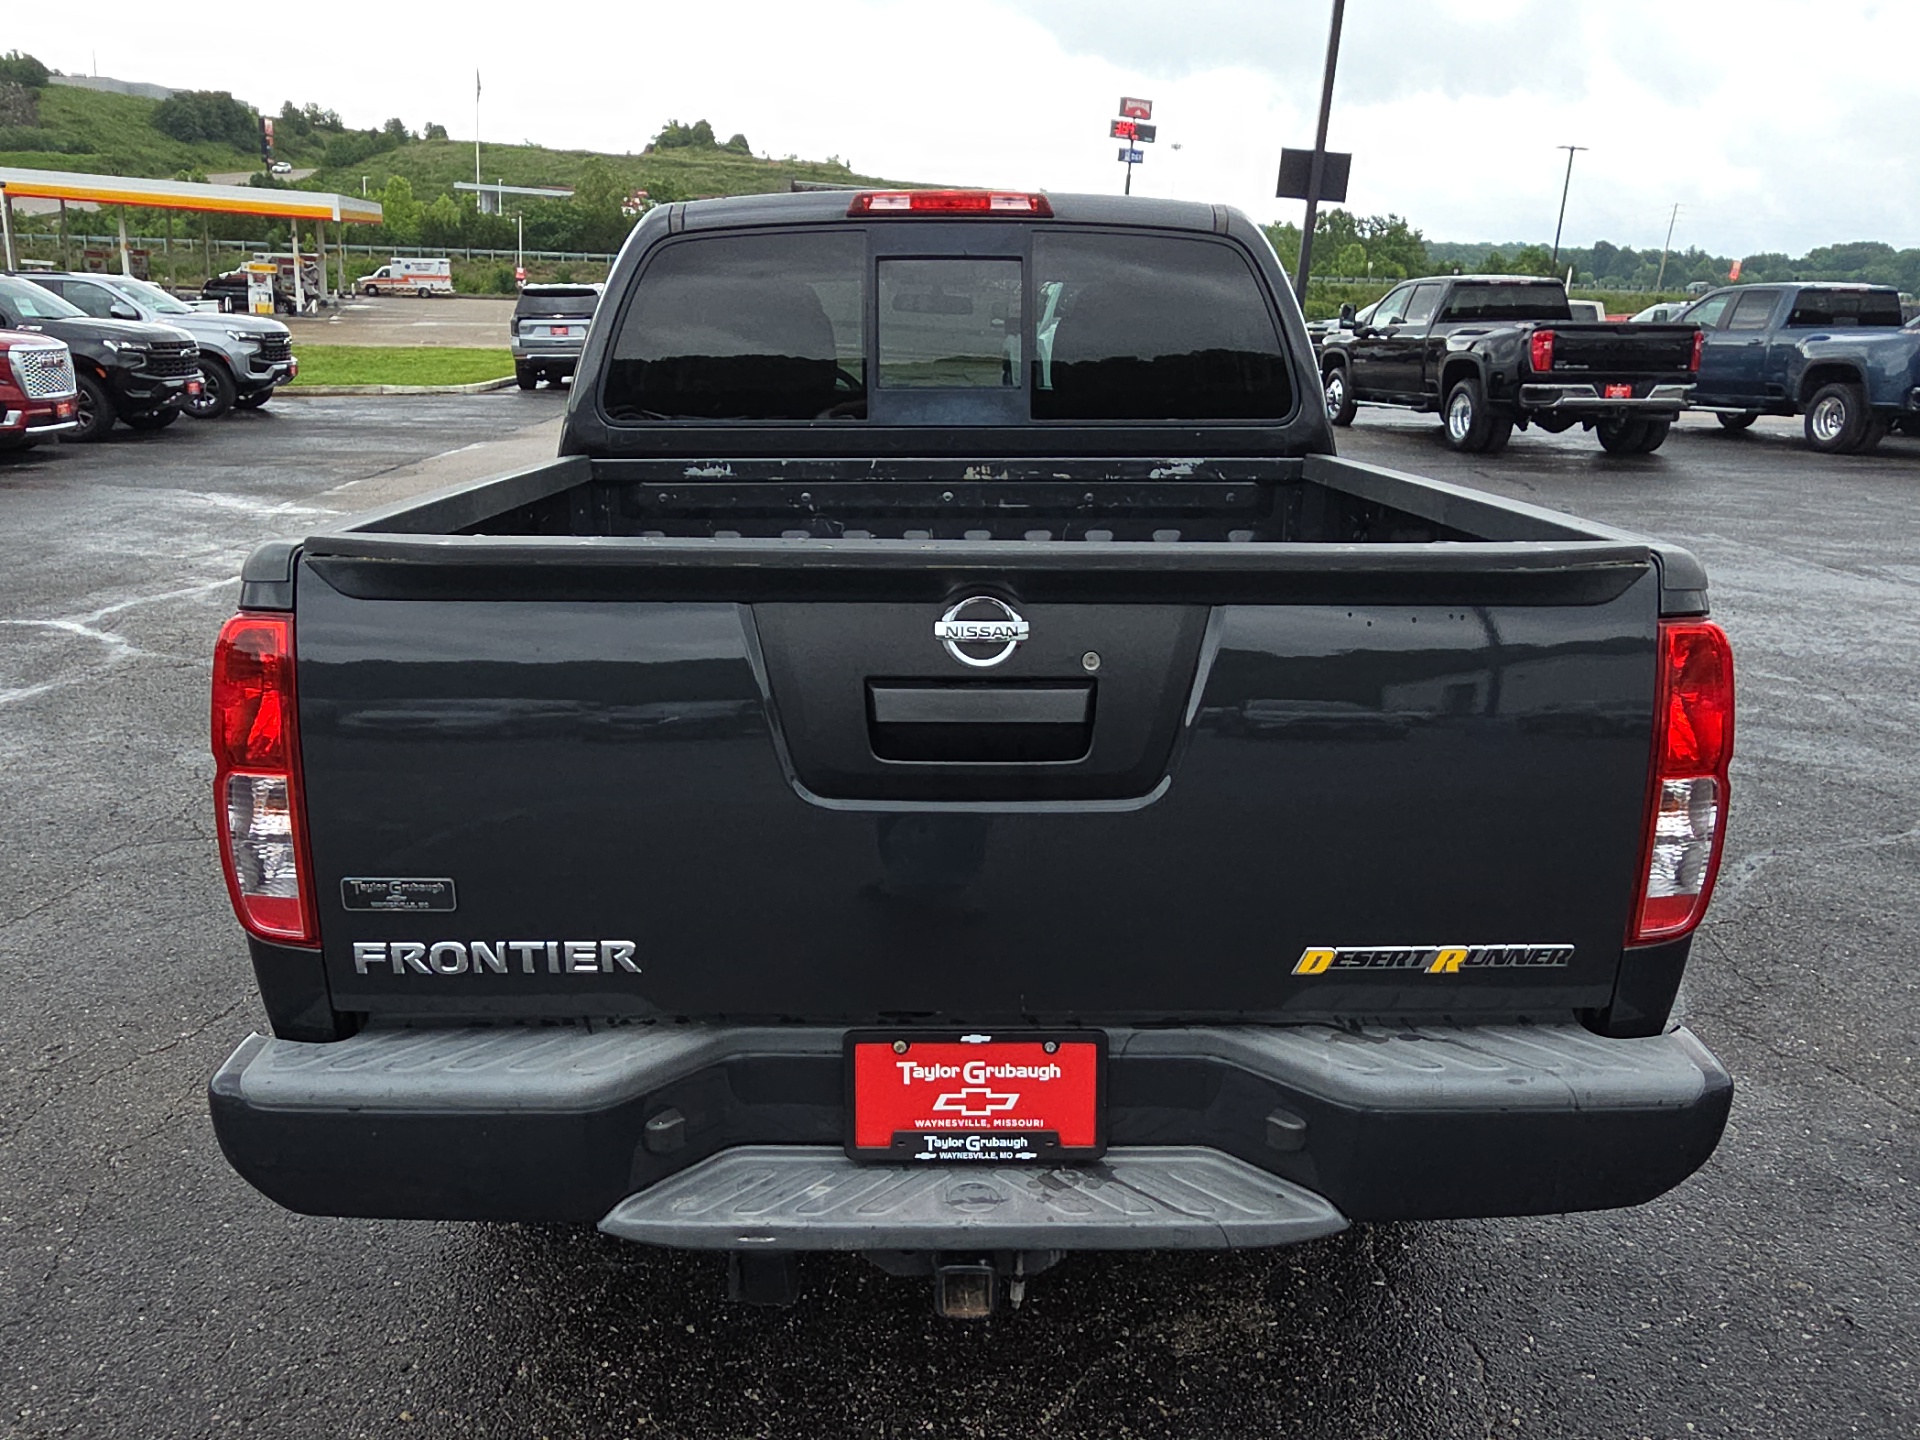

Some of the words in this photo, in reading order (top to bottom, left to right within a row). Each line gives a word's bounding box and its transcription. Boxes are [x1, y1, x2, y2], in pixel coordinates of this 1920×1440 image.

[945, 625, 1019, 638] NISSAN
[350, 881, 387, 894] Taylor
[389, 880, 445, 894] Grubaugh
[353, 940, 642, 974] FRONTIER
[1291, 946, 1432, 975] DESERT
[1424, 944, 1575, 974] RUNNER
[896, 1061, 960, 1085] Taylor
[963, 1061, 1061, 1084] Grubaugh
[914, 1118, 991, 1128] WAYNESVILLE,
[993, 1118, 1044, 1128] MISSOURI
[924, 1135, 964, 1151] Taylor
[966, 1135, 1028, 1151] Grubaugh
[939, 1152, 998, 1160] WAYNESVILLE,
[1000, 1152, 1013, 1160] MO
